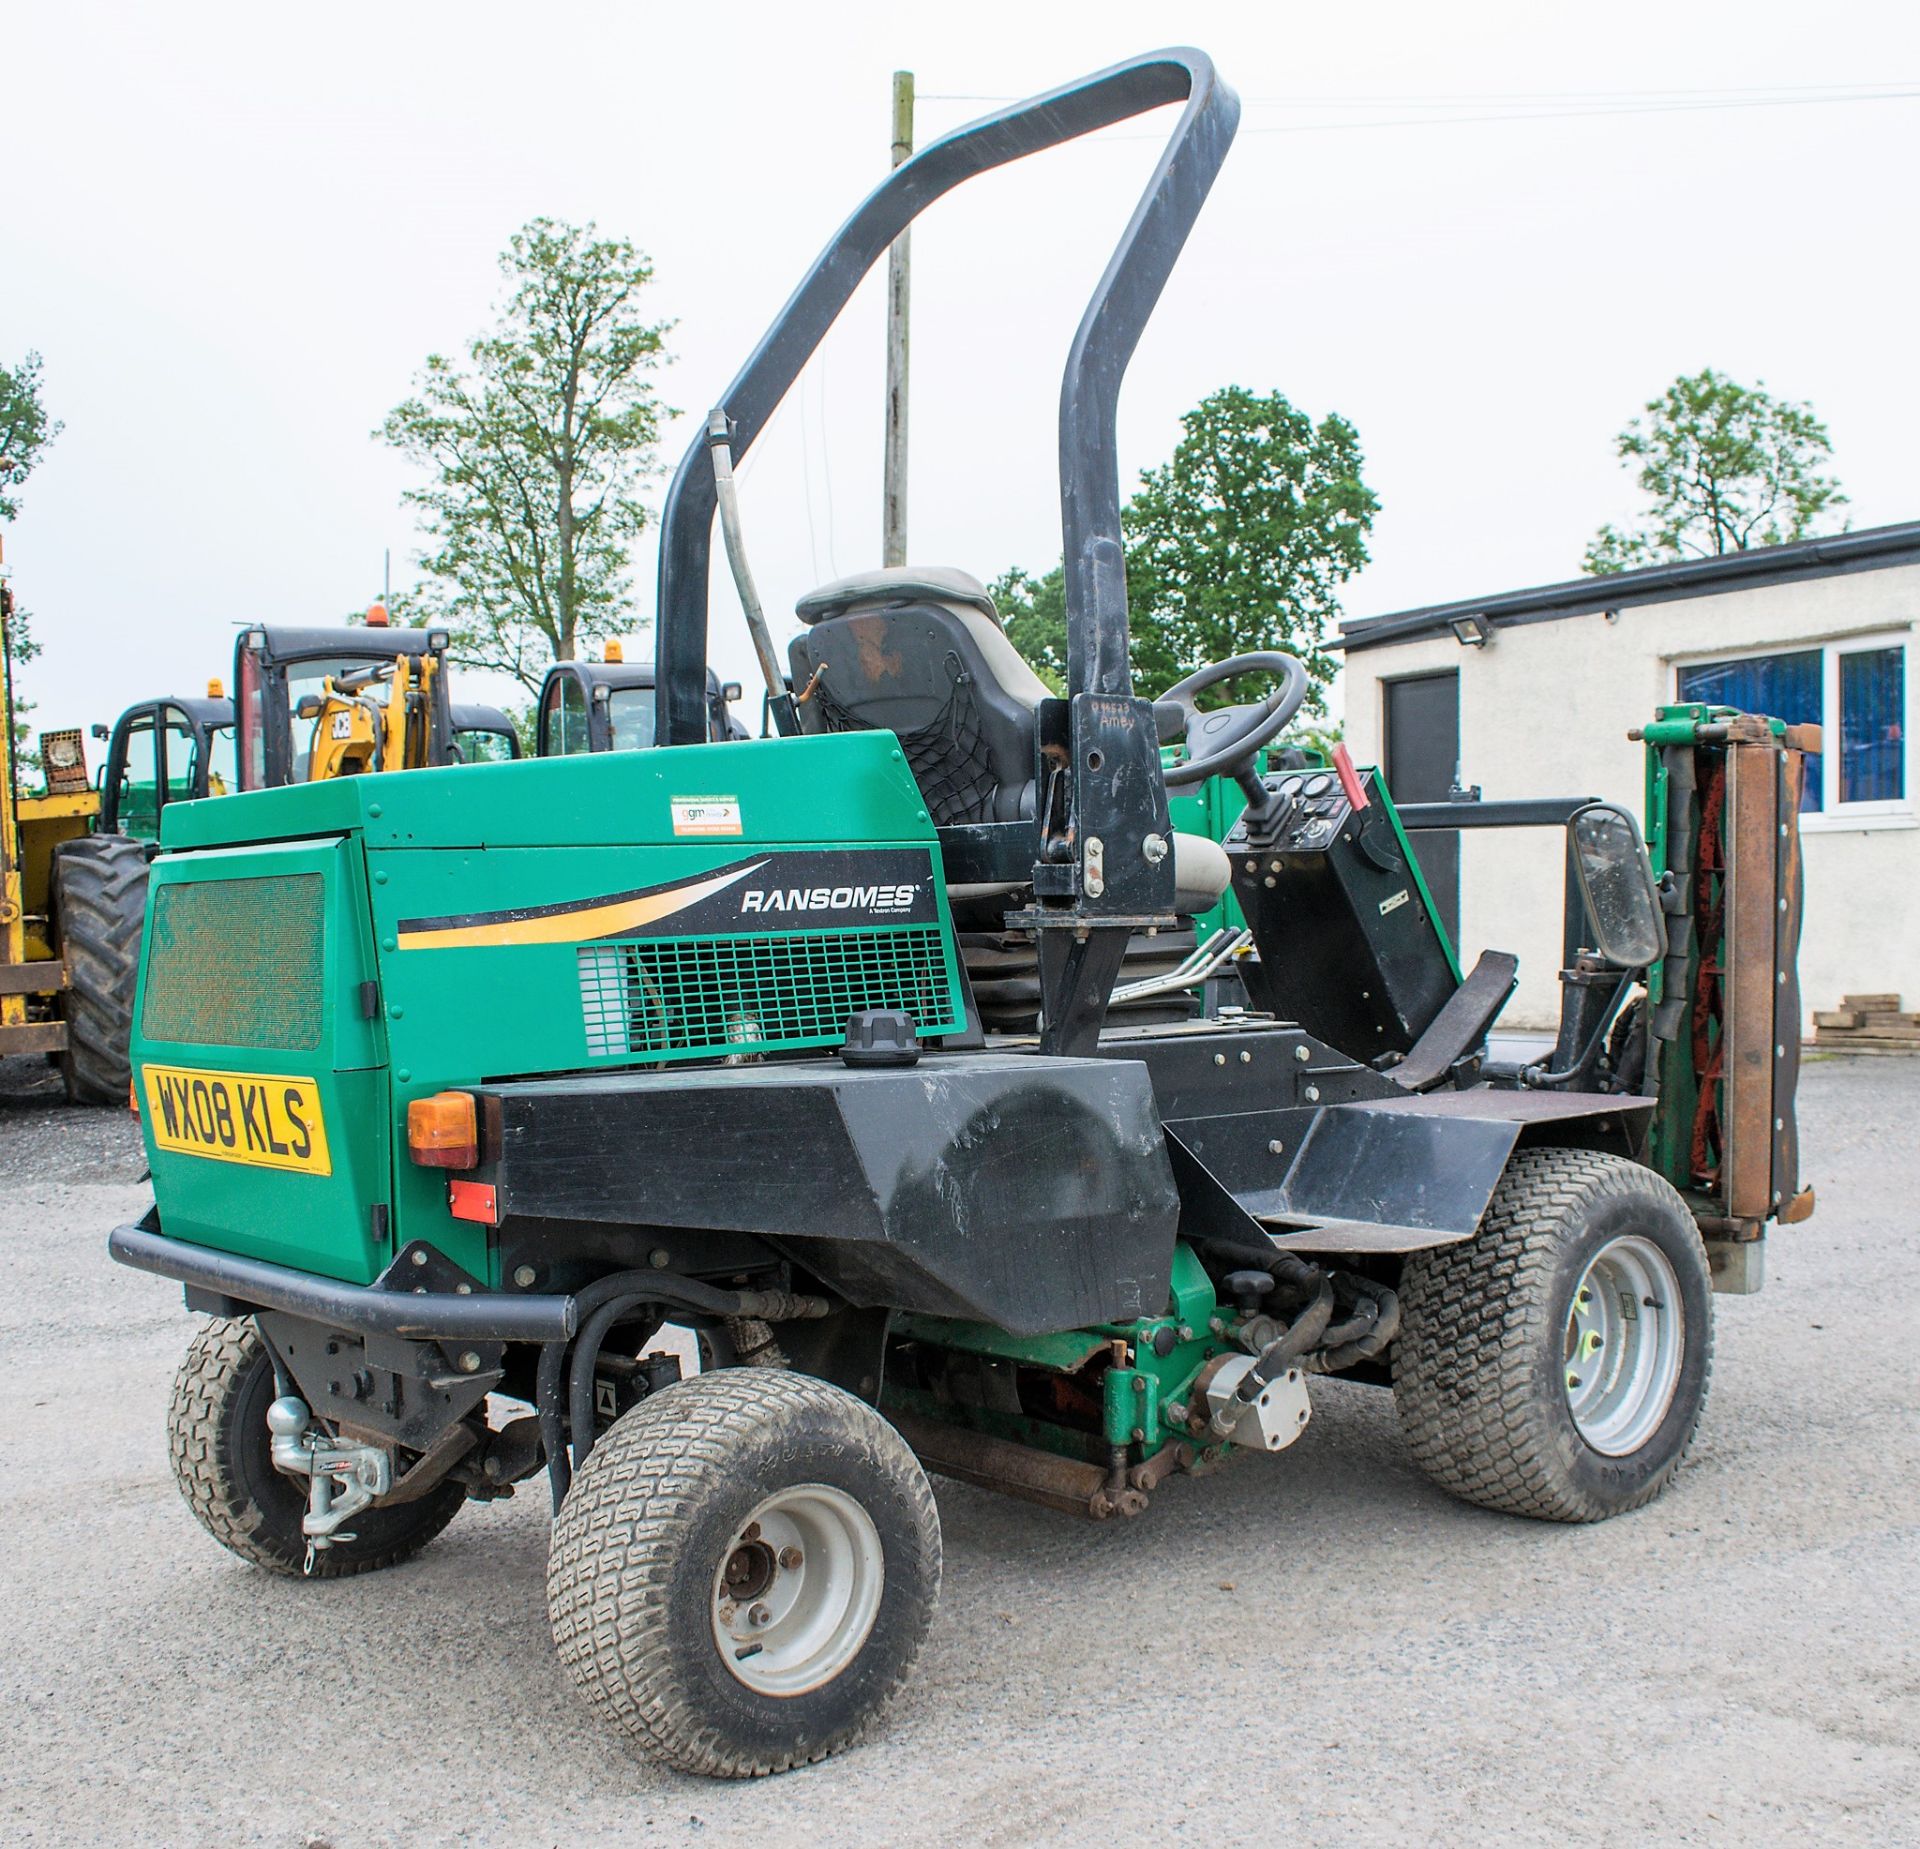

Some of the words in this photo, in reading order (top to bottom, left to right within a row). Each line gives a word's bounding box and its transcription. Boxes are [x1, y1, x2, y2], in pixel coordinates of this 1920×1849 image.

[330, 711, 351, 739] JCB
[741, 885, 915, 912] RANSOMES
[156, 1075, 236, 1148] WX08
[237, 1084, 311, 1159] KLS
